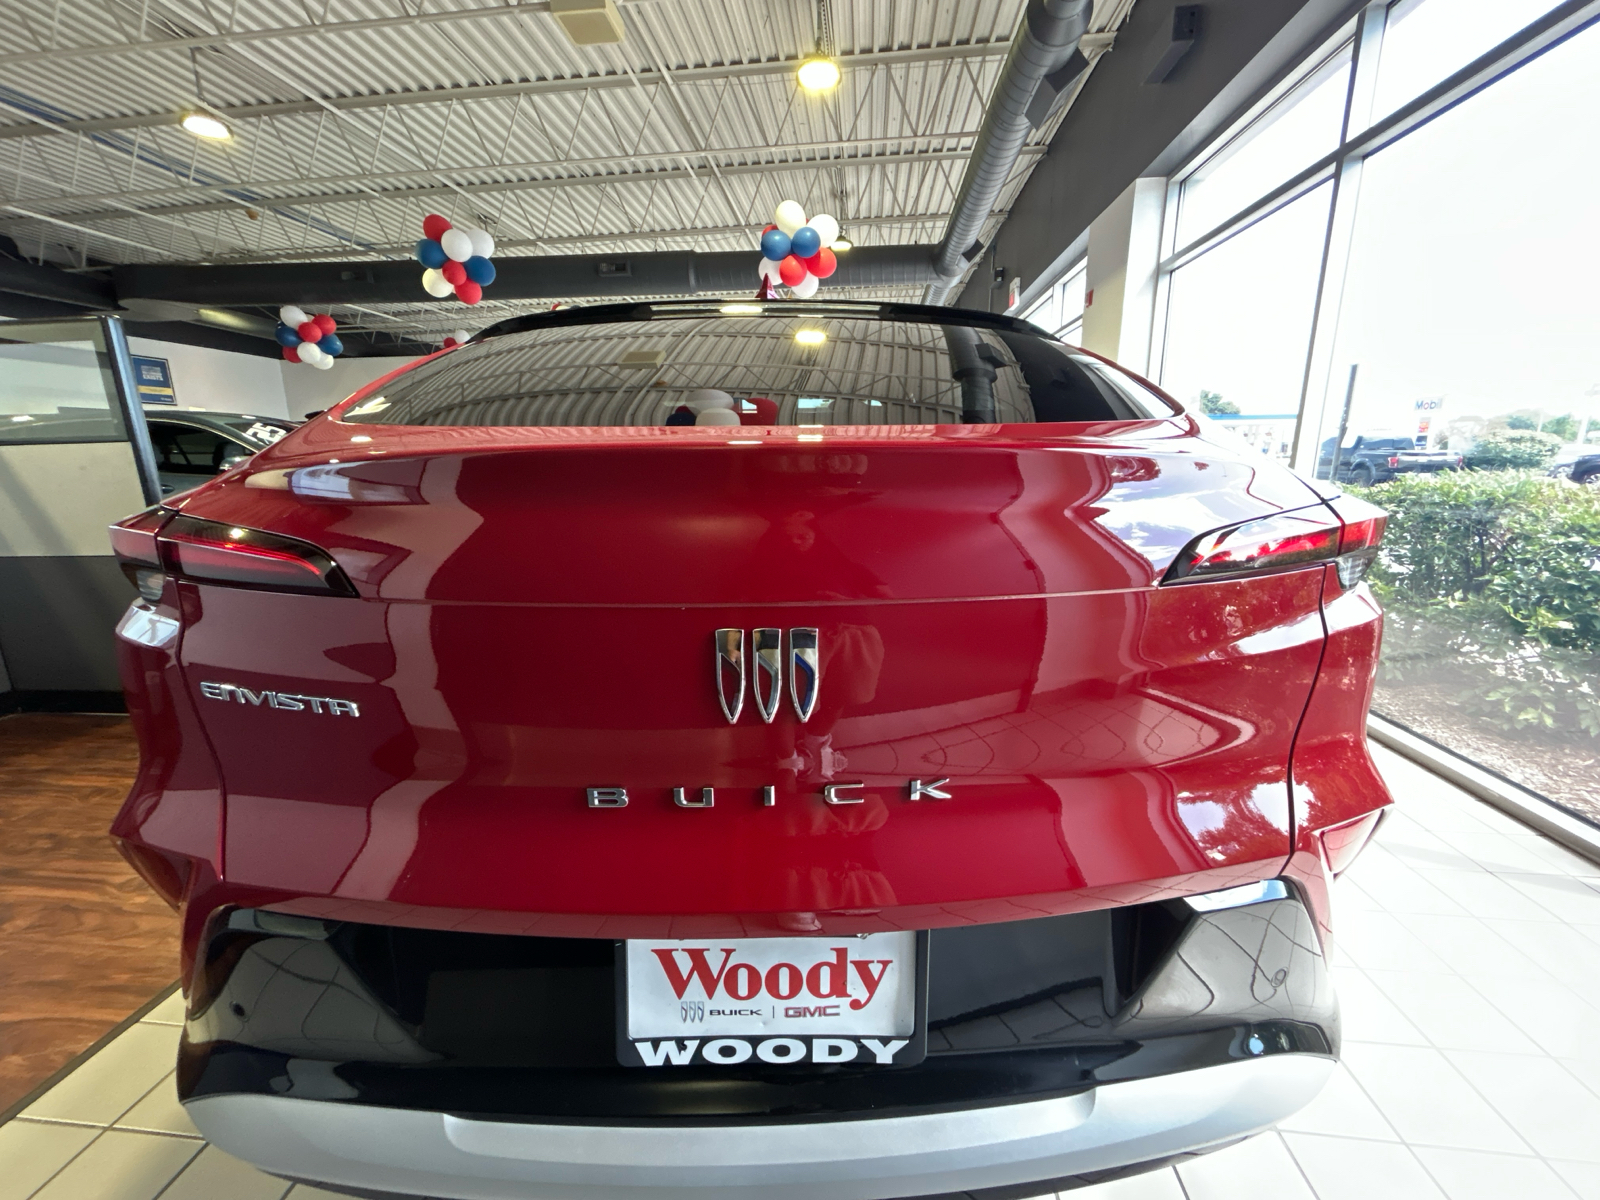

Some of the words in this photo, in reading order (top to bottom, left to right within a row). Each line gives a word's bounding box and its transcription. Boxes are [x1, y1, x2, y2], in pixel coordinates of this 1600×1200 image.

[200, 681, 360, 717] ENVISTA
[586, 778, 952, 808] BUICK
[651, 947, 893, 1010] Woody
[709, 1008, 762, 1016] BUICK
[784, 1005, 840, 1018] GMC
[634, 1038, 909, 1067] WOODY
